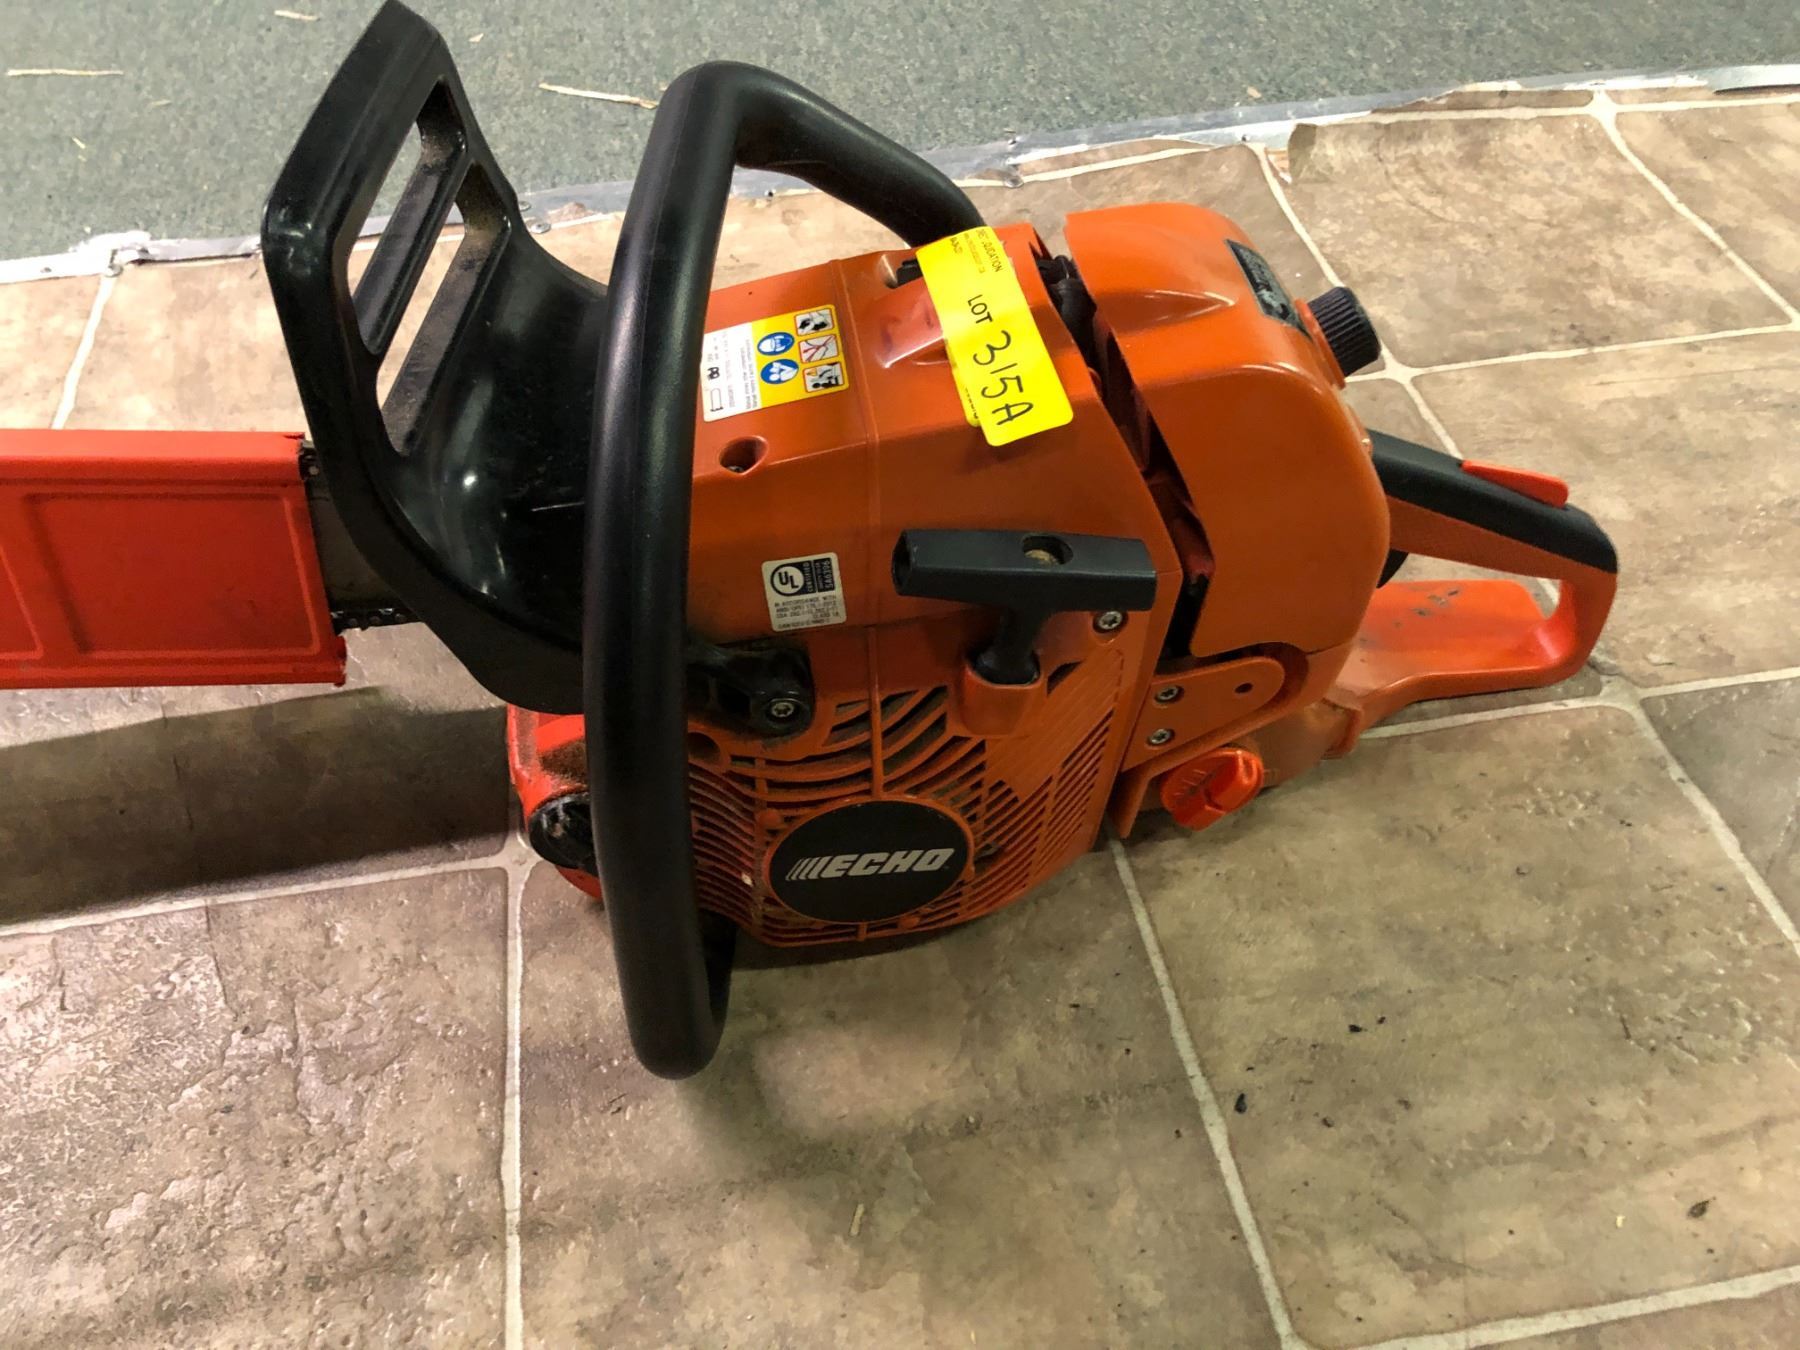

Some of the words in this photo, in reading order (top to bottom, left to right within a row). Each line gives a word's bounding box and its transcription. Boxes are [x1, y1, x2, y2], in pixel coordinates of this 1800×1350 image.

[967, 294, 993, 324] LOT
[972, 330, 1034, 426] 315A
[778, 570, 799, 589] UL
[820, 848, 955, 879] ECHO
